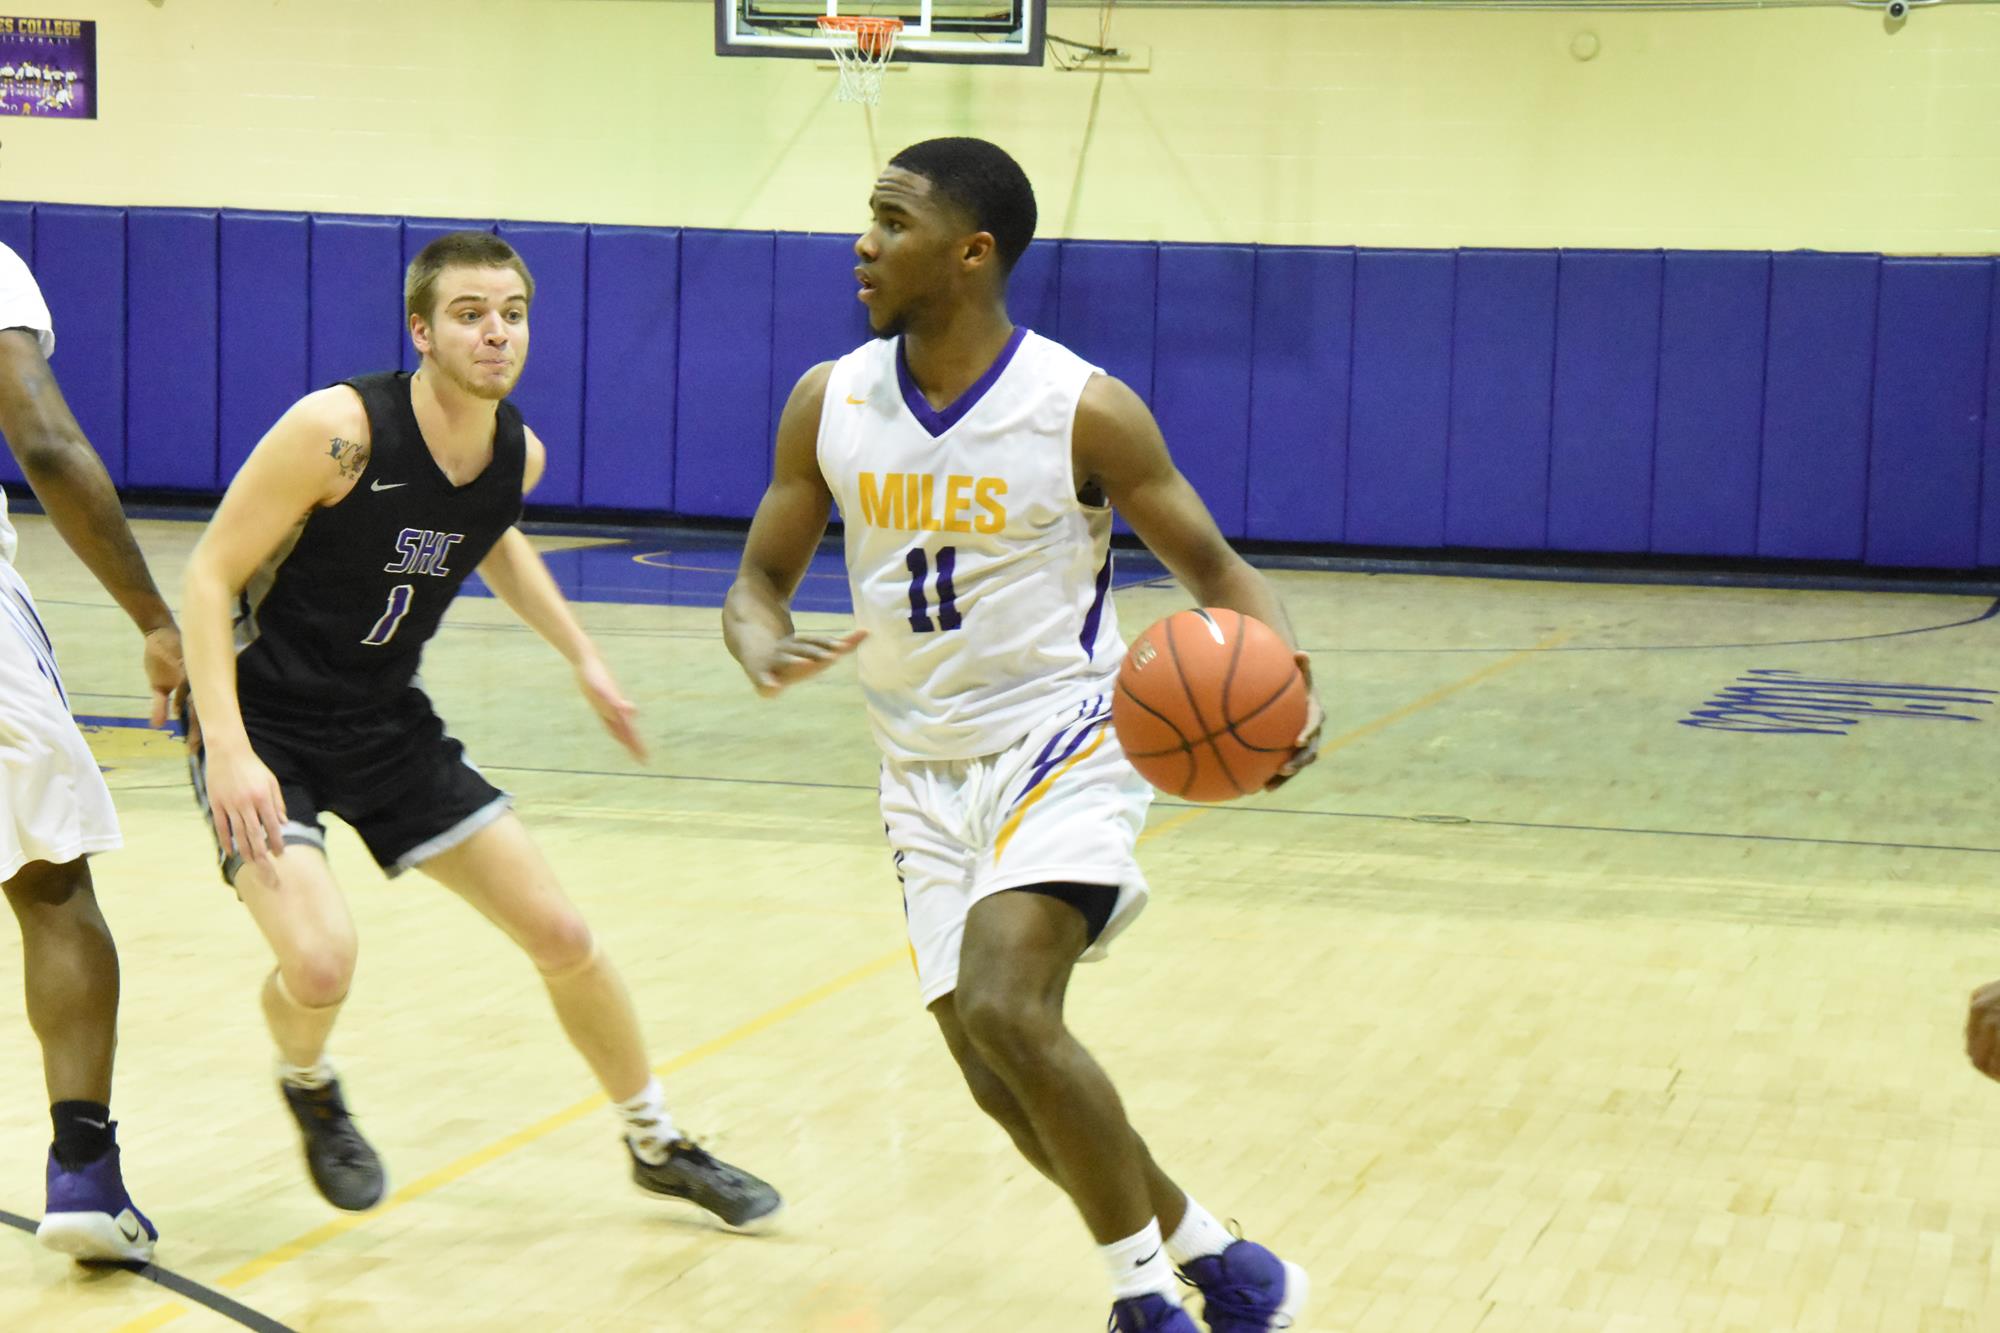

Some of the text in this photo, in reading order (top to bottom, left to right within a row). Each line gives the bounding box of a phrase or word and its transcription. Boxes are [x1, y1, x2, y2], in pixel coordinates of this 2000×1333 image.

[18, 19, 81, 37] COLLEGE
[858, 472, 1008, 534] MILES
[384, 527, 465, 577] SHC
[360, 584, 415, 646] 1
[906, 546, 962, 633] 11
